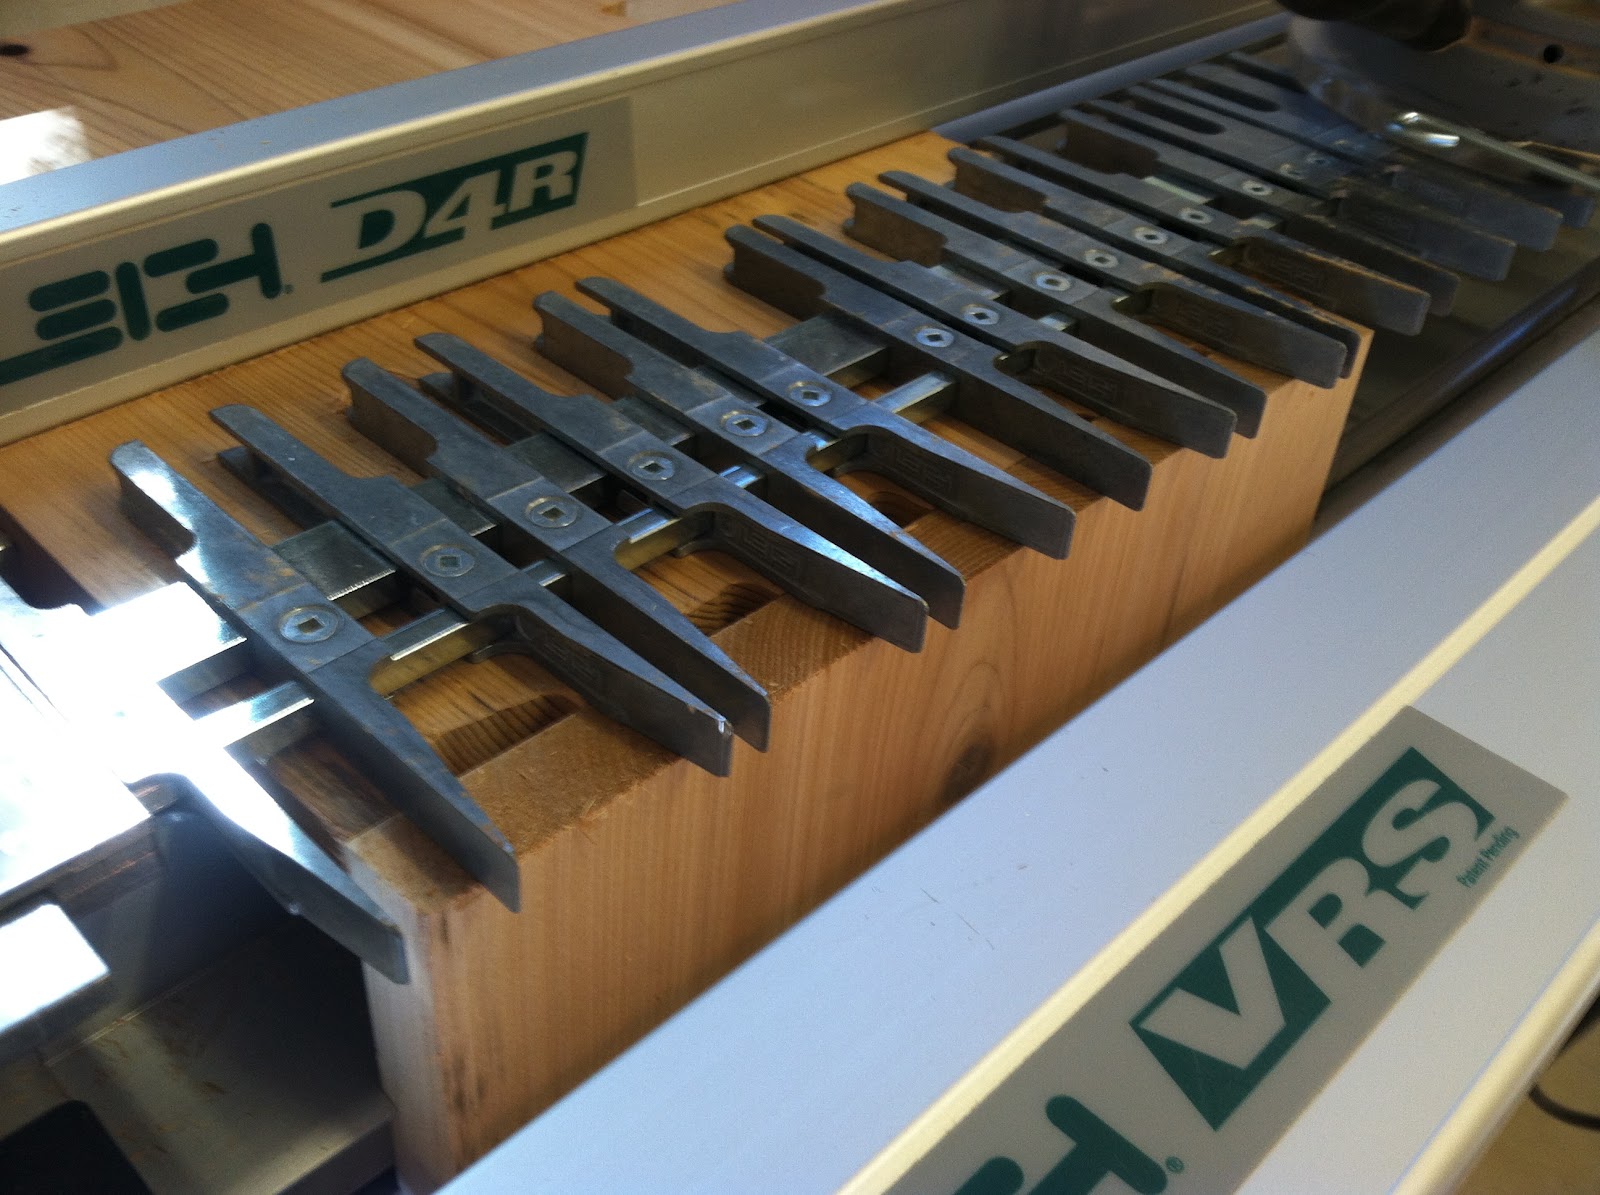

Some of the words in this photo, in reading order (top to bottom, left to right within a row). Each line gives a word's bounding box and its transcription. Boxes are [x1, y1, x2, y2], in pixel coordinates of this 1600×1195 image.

[336, 146, 580, 278] D4R
[1455, 858, 1490, 889] Patent
[1479, 825, 1520, 862] Pending
[1136, 775, 1483, 1075] VRS
